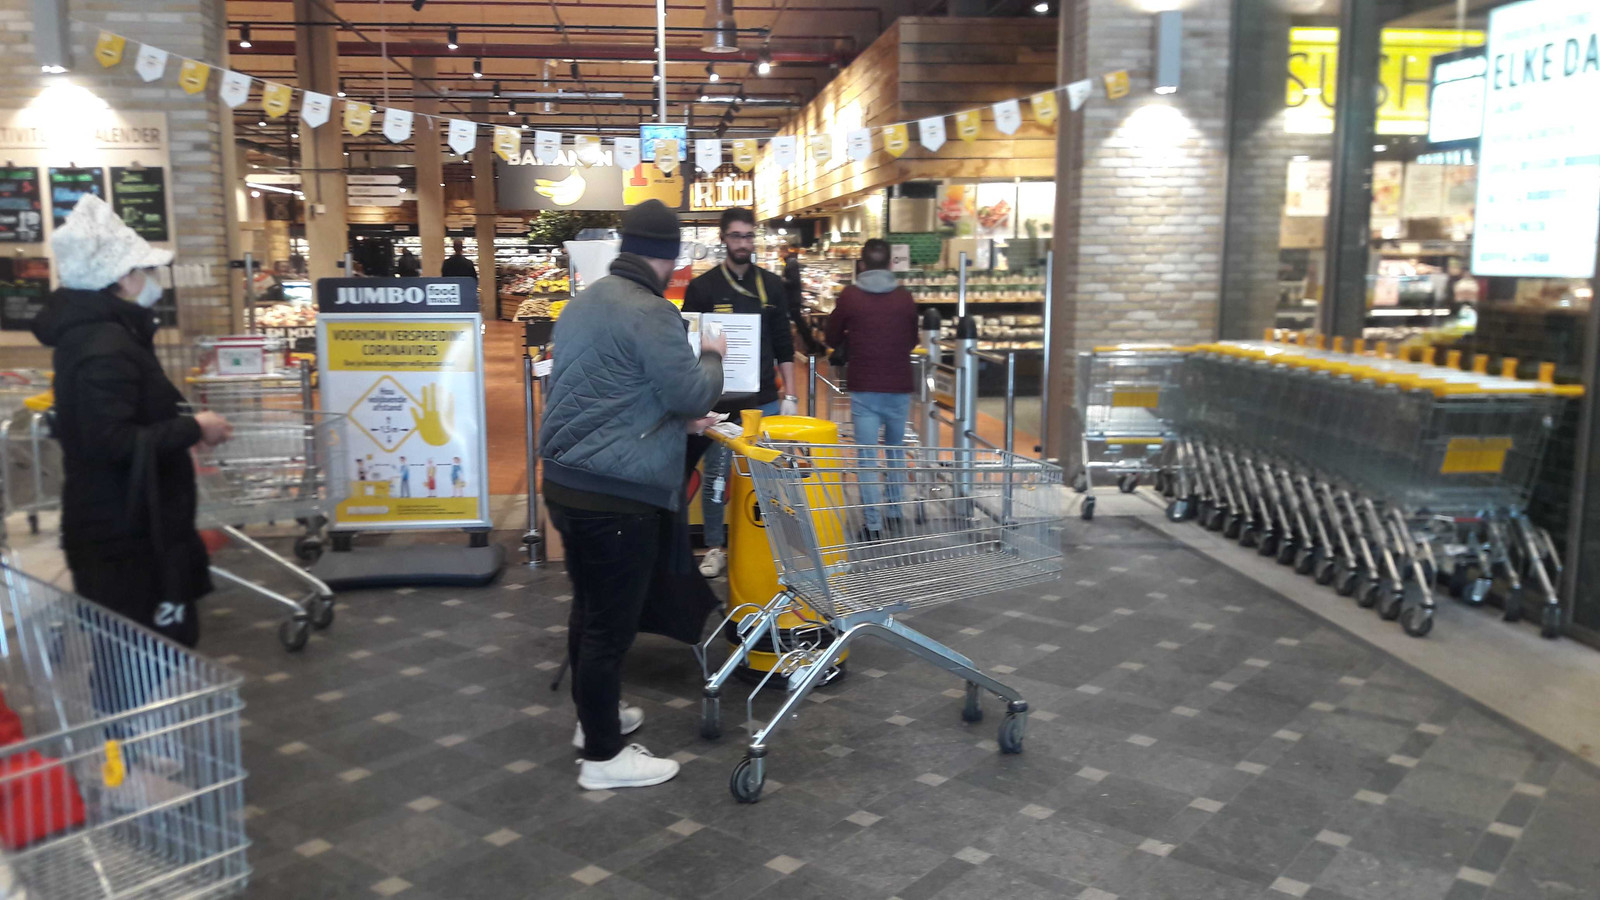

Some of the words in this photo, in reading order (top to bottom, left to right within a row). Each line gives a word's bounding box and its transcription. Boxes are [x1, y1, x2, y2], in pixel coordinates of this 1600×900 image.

[1494, 43, 1554, 91] ELKE
[335, 286, 425, 305] JUMBO
[429, 286, 457, 296] food
[332, 330, 386, 342] VOORKOM
[362, 345, 438, 356] CORONAVIRUS
